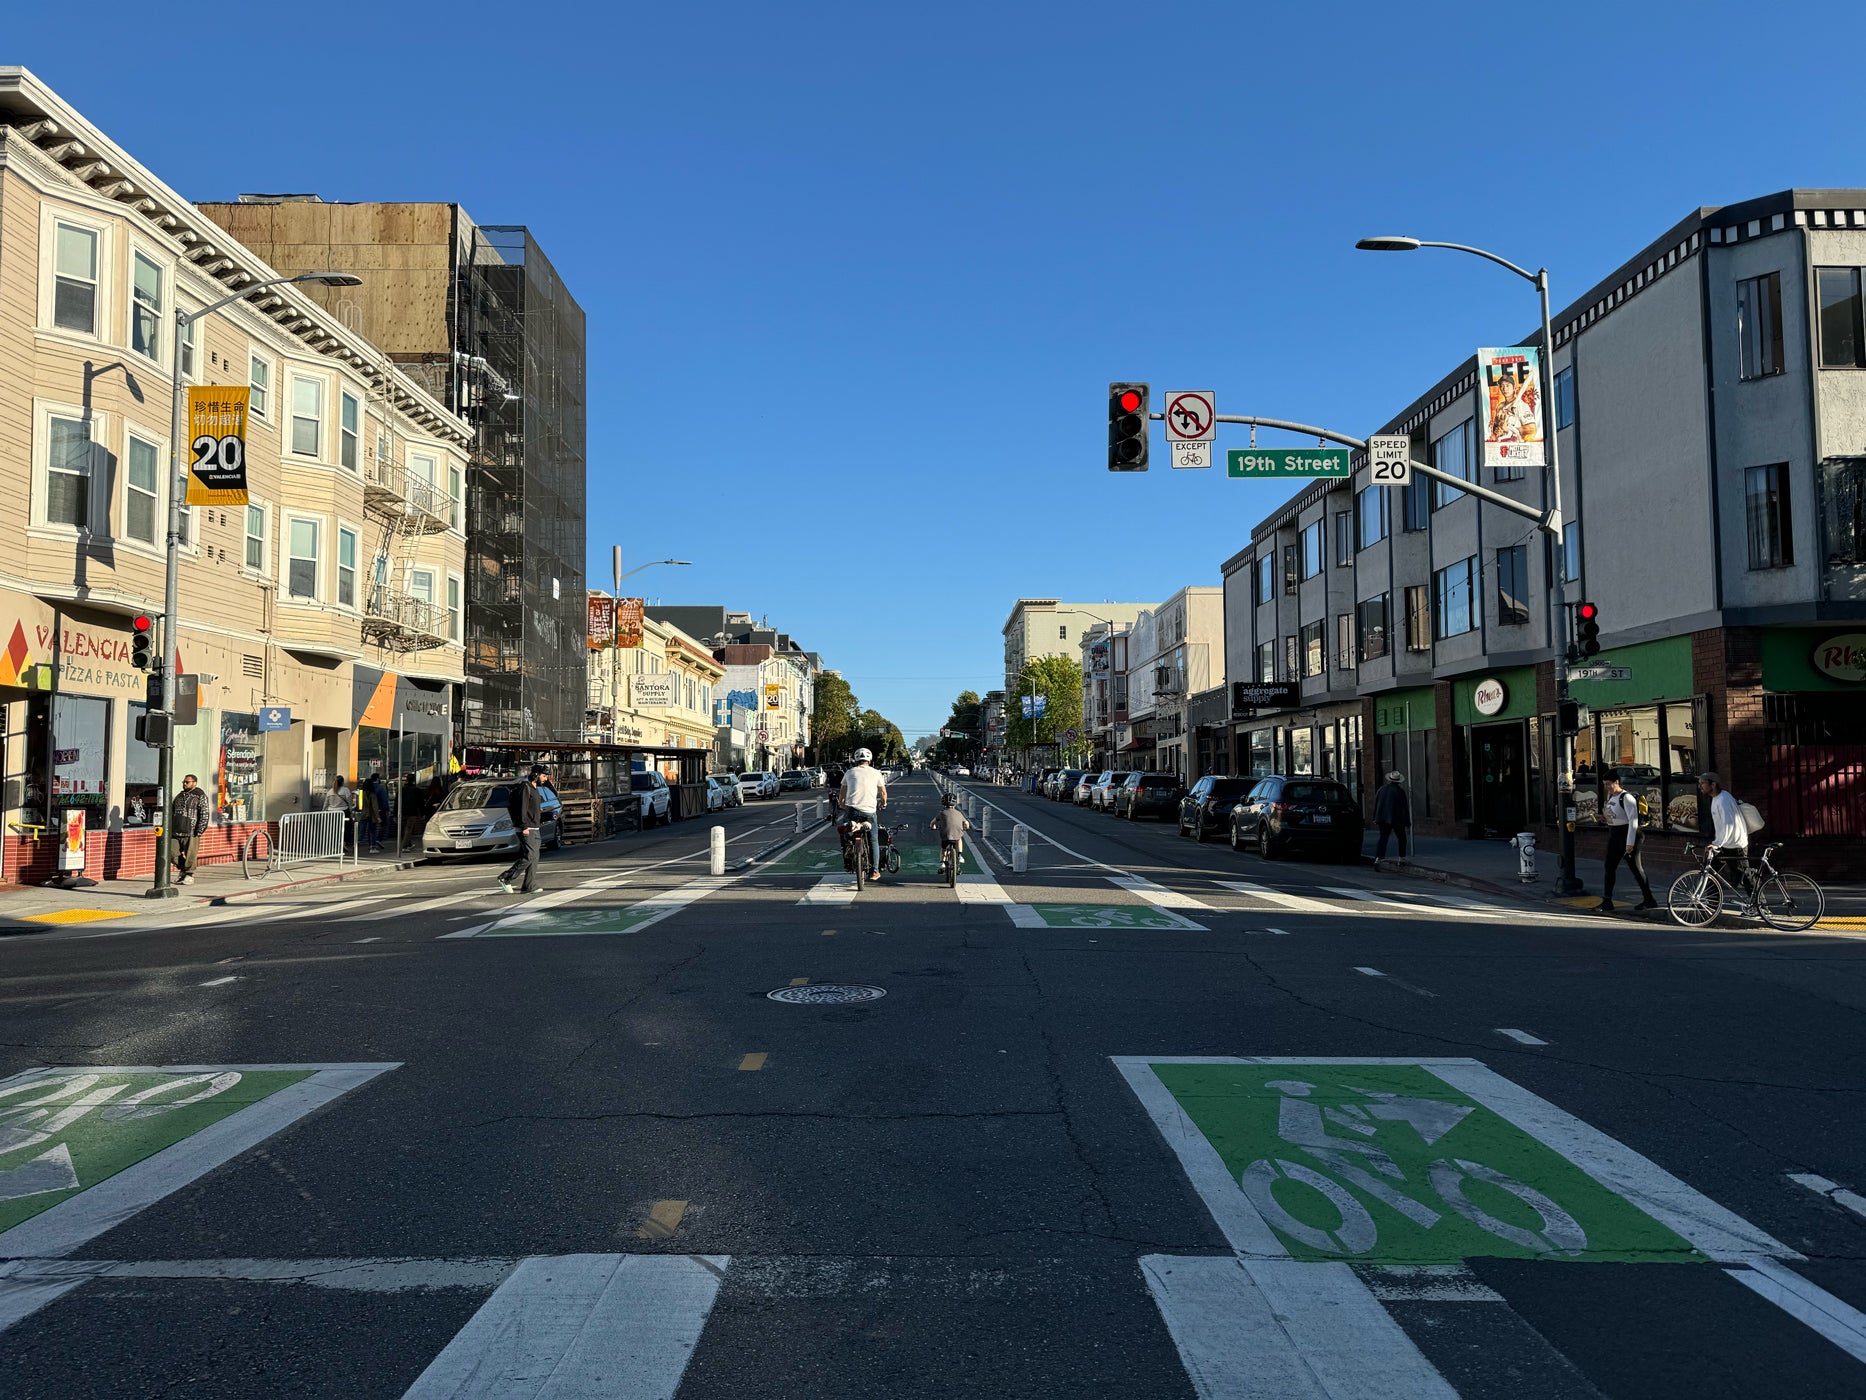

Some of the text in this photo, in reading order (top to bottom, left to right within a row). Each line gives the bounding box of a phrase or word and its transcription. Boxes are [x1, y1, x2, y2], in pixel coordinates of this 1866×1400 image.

[194, 401, 245, 413] 珍惜生命
[1175, 442, 1207, 450] EXCEPT
[1373, 440, 1407, 449] SPEED
[193, 435, 242, 471] 20
[1376, 450, 1403, 459] LIMIT
[1238, 456, 1340, 471] 19th Street
[1375, 461, 1406, 480] 20
[593, 616, 602, 644] STATE
[36, 624, 131, 665] VALENCIA
[1578, 669, 1624, 678] 19TH ST
[97, 671, 104, 684] &
[106, 671, 140, 689] PASTA
[1242, 687, 1289, 697] aggregate
[767, 694, 778, 703] 20
[1242, 695, 1271, 704] supply
